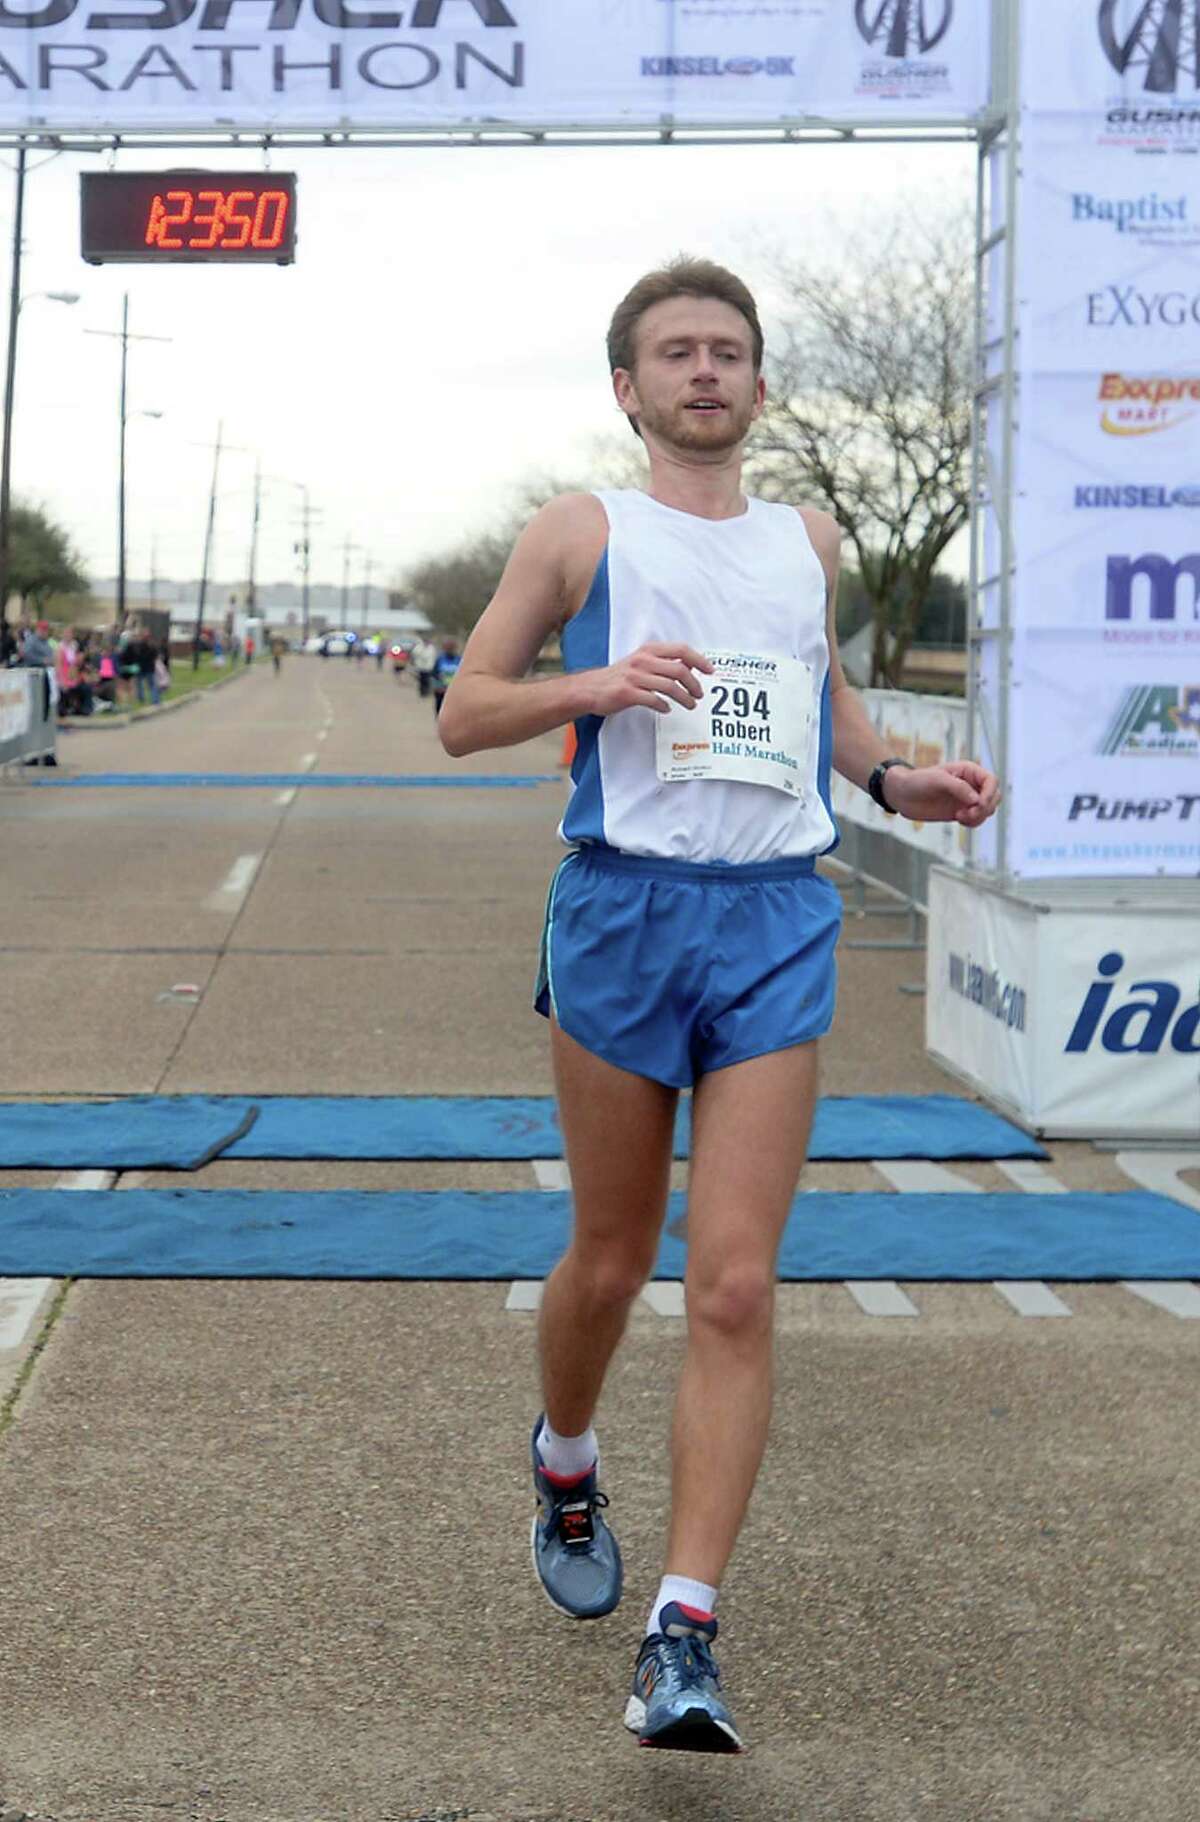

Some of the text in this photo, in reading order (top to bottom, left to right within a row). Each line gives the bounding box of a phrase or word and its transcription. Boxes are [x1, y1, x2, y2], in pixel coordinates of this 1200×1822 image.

[641, 57, 724, 76] KINSEL
[1071, 193, 1187, 232] Baptist
[1075, 486, 1172, 508] KINSEL
[711, 686, 770, 720] 294
[712, 719, 771, 743] Robert
[712, 742, 798, 769] Half Marathon
